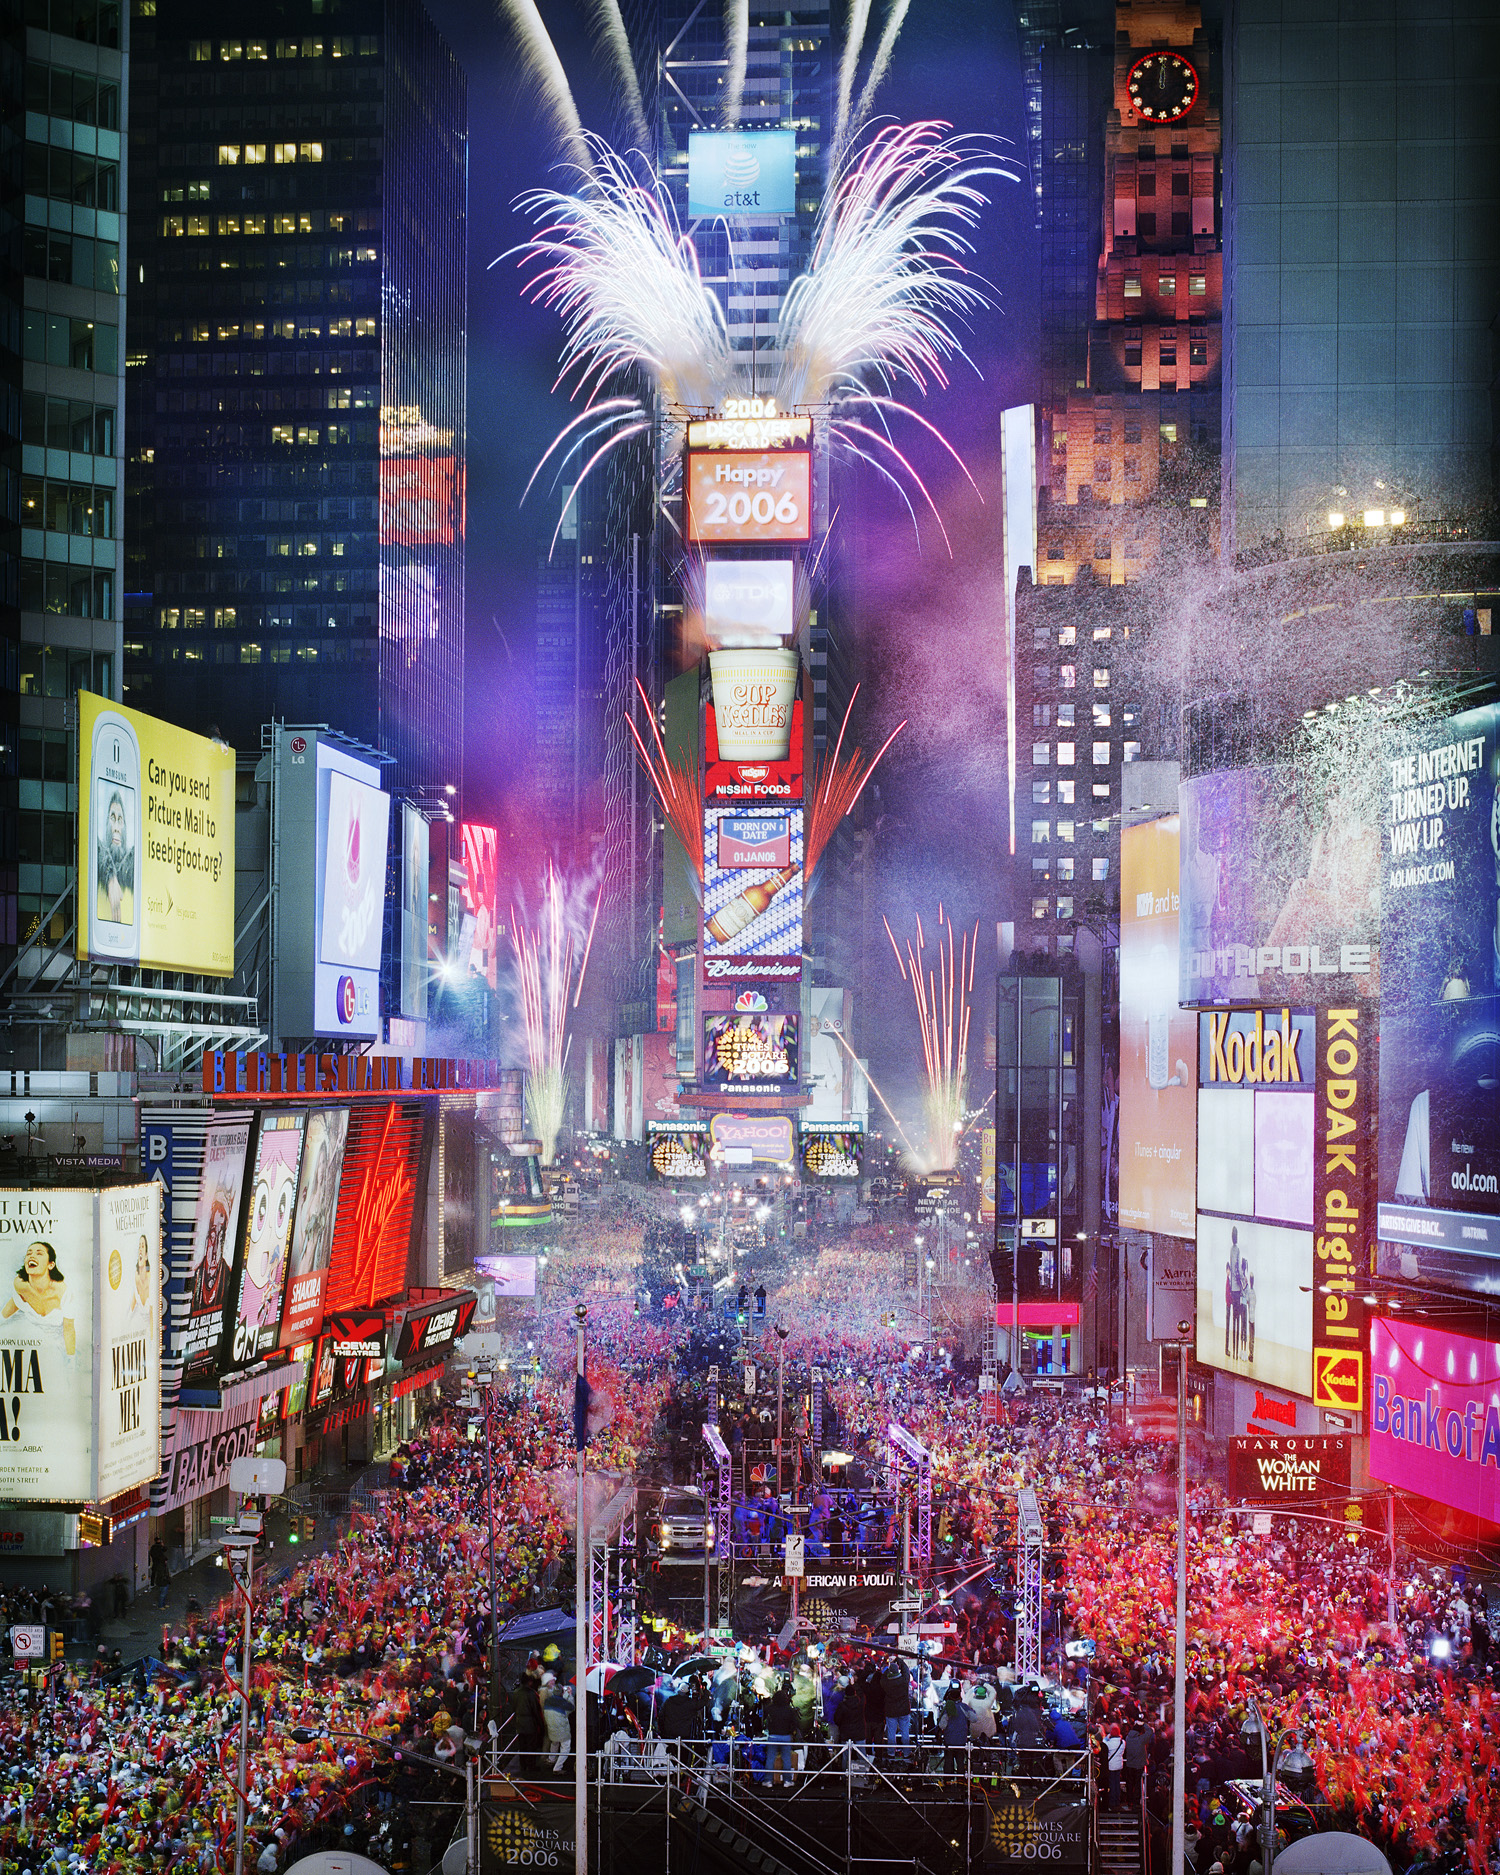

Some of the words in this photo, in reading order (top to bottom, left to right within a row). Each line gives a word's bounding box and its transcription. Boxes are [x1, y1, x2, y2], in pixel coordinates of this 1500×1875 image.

[727, 142, 740, 150] The
[723, 190, 761, 207] at&t
[724, 398, 777, 419] 2006
[705, 420, 792, 438] DISCOVER
[728, 436, 771, 449] CARD
[715, 463, 786, 488] Happy
[703, 490, 800, 526] 2006
[730, 683, 777, 706] CUP
[720, 703, 788, 729] NOODLES
[291, 755, 306, 765] LG
[1390, 755, 1417, 789] THE
[1418, 736, 1486, 784] INTERNET
[105, 766, 128, 783] SAMSUNG
[147, 757, 167, 788] Can
[168, 770, 187, 798] you
[189, 776, 210, 801] send
[741, 767, 766, 779] NISSIN
[715, 784, 752, 795] NISSIN
[754, 784, 791, 795] FOODS
[1390, 782, 1446, 823] TURNED
[1448, 776, 1470, 810] UP.
[147, 795, 182, 829] Picture
[184, 806, 204, 836] Mail
[206, 813, 216, 838] to
[733, 822, 760, 832] BORN
[761, 822, 777, 832] ON
[742, 831, 768, 840] DATE
[1390, 821, 1421, 856] WAY
[1422, 817, 1445, 850] UP.
[147, 831, 223, 883] iseebigfoot.org?
[733, 851, 777, 863] 01JAN06
[1389, 860, 1455, 889] AOLMUSIC.COM
[147, 896, 164, 914] Sprint
[1154, 888, 1170, 914] and
[704, 959, 801, 977] Budweiser
[1185, 944, 1372, 979] OUTHPOLE
[357, 985, 370, 1017] LG
[736, 1042, 771, 1052] TIMES
[1209, 1008, 1302, 1084] Kodak
[741, 1051, 787, 1061] SQUARE
[732, 1059, 790, 1075] 2006
[720, 1083, 781, 1093] Panasonic
[1325, 1009, 1359, 1176] KODAK
[647, 1120, 707, 1131] Panasonic
[715, 1125, 788, 1140] YAHOO!
[800, 1121, 860, 1132] Panasonic
[1134, 1141, 1153, 1158] iTunes
[1153, 1146, 1158, 1157] +
[1158, 1143, 1182, 1164] cingular
[1451, 1138, 1461, 1153] the
[1460, 1143, 1475, 1154] new
[55, 1157, 86, 1166] VISTA
[88, 1157, 121, 1166] MEDIA
[824, 1159, 858, 1167] SQUARE
[664, 1166, 707, 1177] 2006
[818, 1165, 859, 1176] 2006
[18, 1200, 52, 1215] FUN
[114, 1195, 150, 1214] WORLDWIDE
[1380, 1214, 1406, 1231] ARTISTS
[1405, 1217, 1421, 1234] GIVE
[1316, 1189, 1360, 1338] digital
[291, 1276, 321, 1304] SHAKIRA
[426, 1309, 458, 1335] LOEWS
[233, 1314, 259, 1362] CN
[332, 1341, 381, 1350] LOEWS
[424, 1328, 453, 1348] THEATRES
[111, 1338, 148, 1391] MAMMA
[1326, 1373, 1357, 1387] Kodak
[119, 1385, 140, 1435] MIA!
[1373, 1373, 1442, 1452] Bank
[1445, 1400, 1478, 1462] of
[1236, 1439, 1344, 1450] MARQUIS
[177, 1443, 212, 1494] BAR
[214, 1423, 258, 1476] CODE
[1283, 1453, 1297, 1461] THE
[17, 1466, 43, 1474] THEATRE
[1256, 1458, 1321, 1474] WOMAN
[1260, 1475, 1317, 1491] WHITE
[821, 1608, 848, 1616] TIMES
[826, 1615, 861, 1625] SQUE
[520, 1827, 560, 1840] TIMES
[1024, 1821, 1063, 1832] TIMES
[528, 1839, 577, 1852] SQUARE
[1032, 1832, 1082, 1845] SQUARE
[506, 1848, 559, 1867] 2006
[1010, 1842, 1062, 1860] 2006
